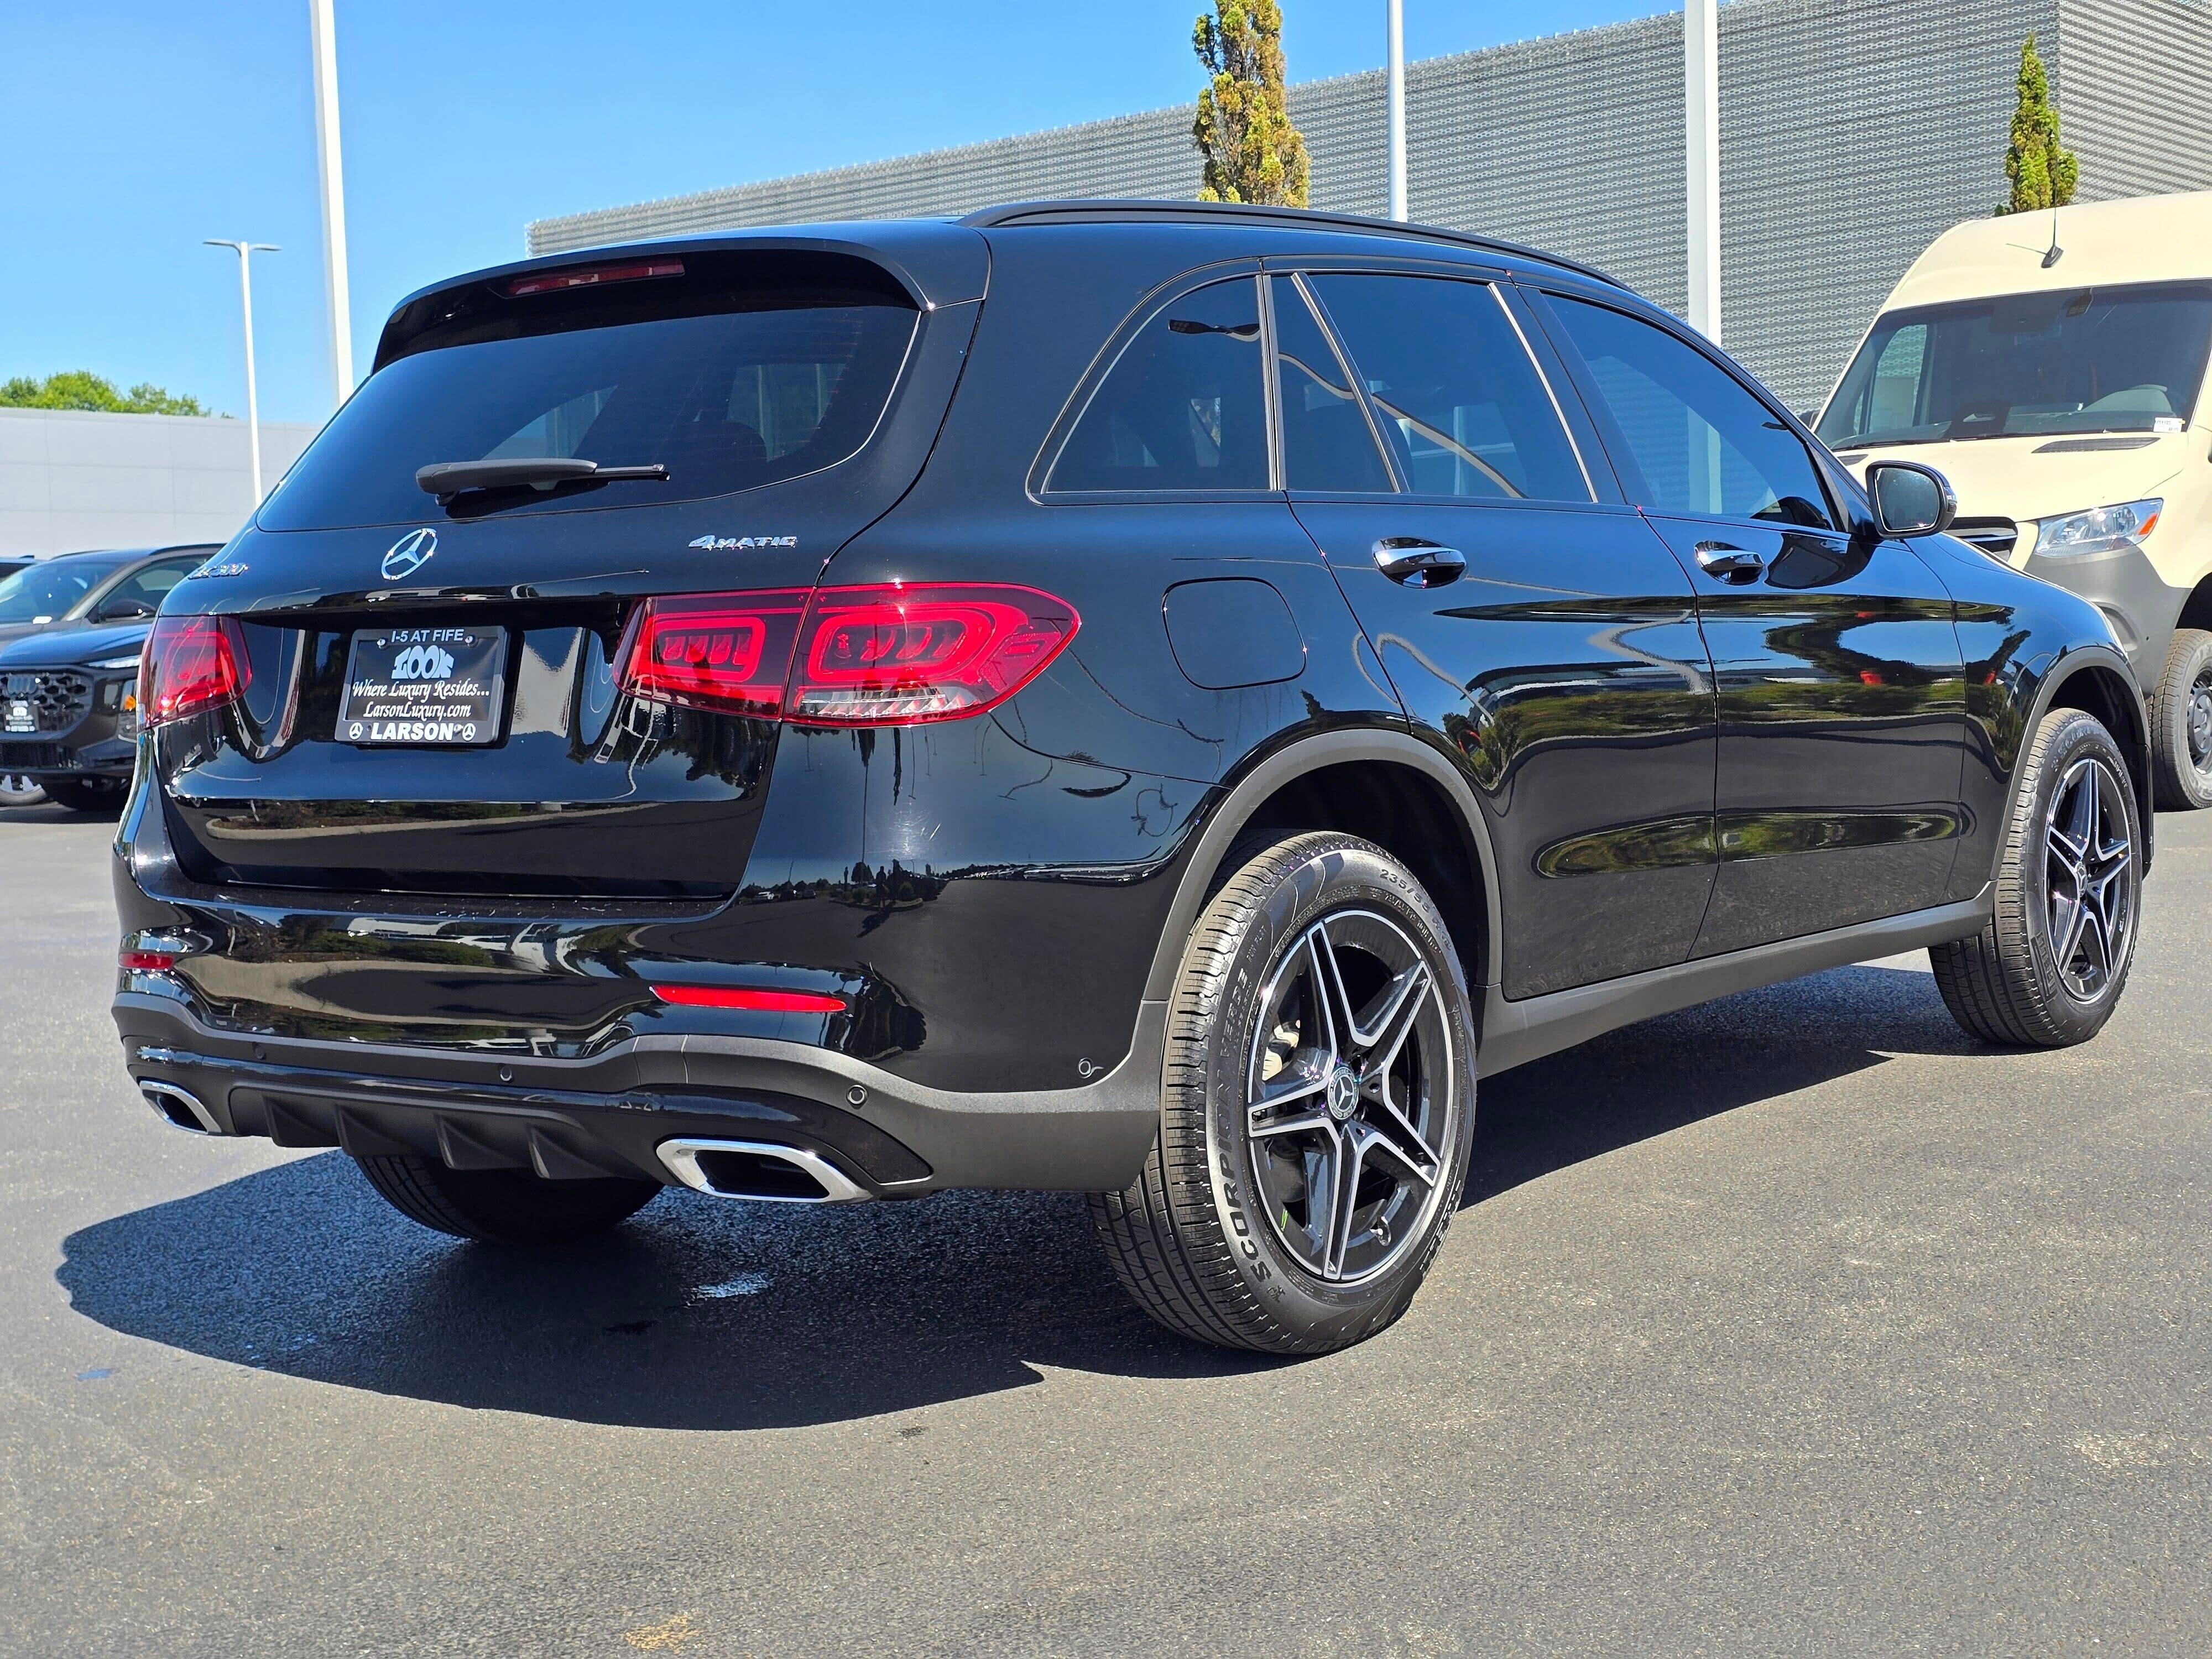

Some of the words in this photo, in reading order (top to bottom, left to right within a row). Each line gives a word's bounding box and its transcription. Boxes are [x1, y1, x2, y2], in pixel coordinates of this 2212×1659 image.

[688, 535, 797, 550] 4MATIC
[391, 630, 409, 643] I-5
[410, 630, 430, 642] AT
[433, 629, 464, 642] FIFE
[352, 679, 387, 697] Where
[388, 681, 432, 703] Luxury
[363, 701, 471, 721] LarsonLuxury.com
[371, 722, 455, 740] LARSON
[1216, 1069, 1272, 1283] SCORPION
